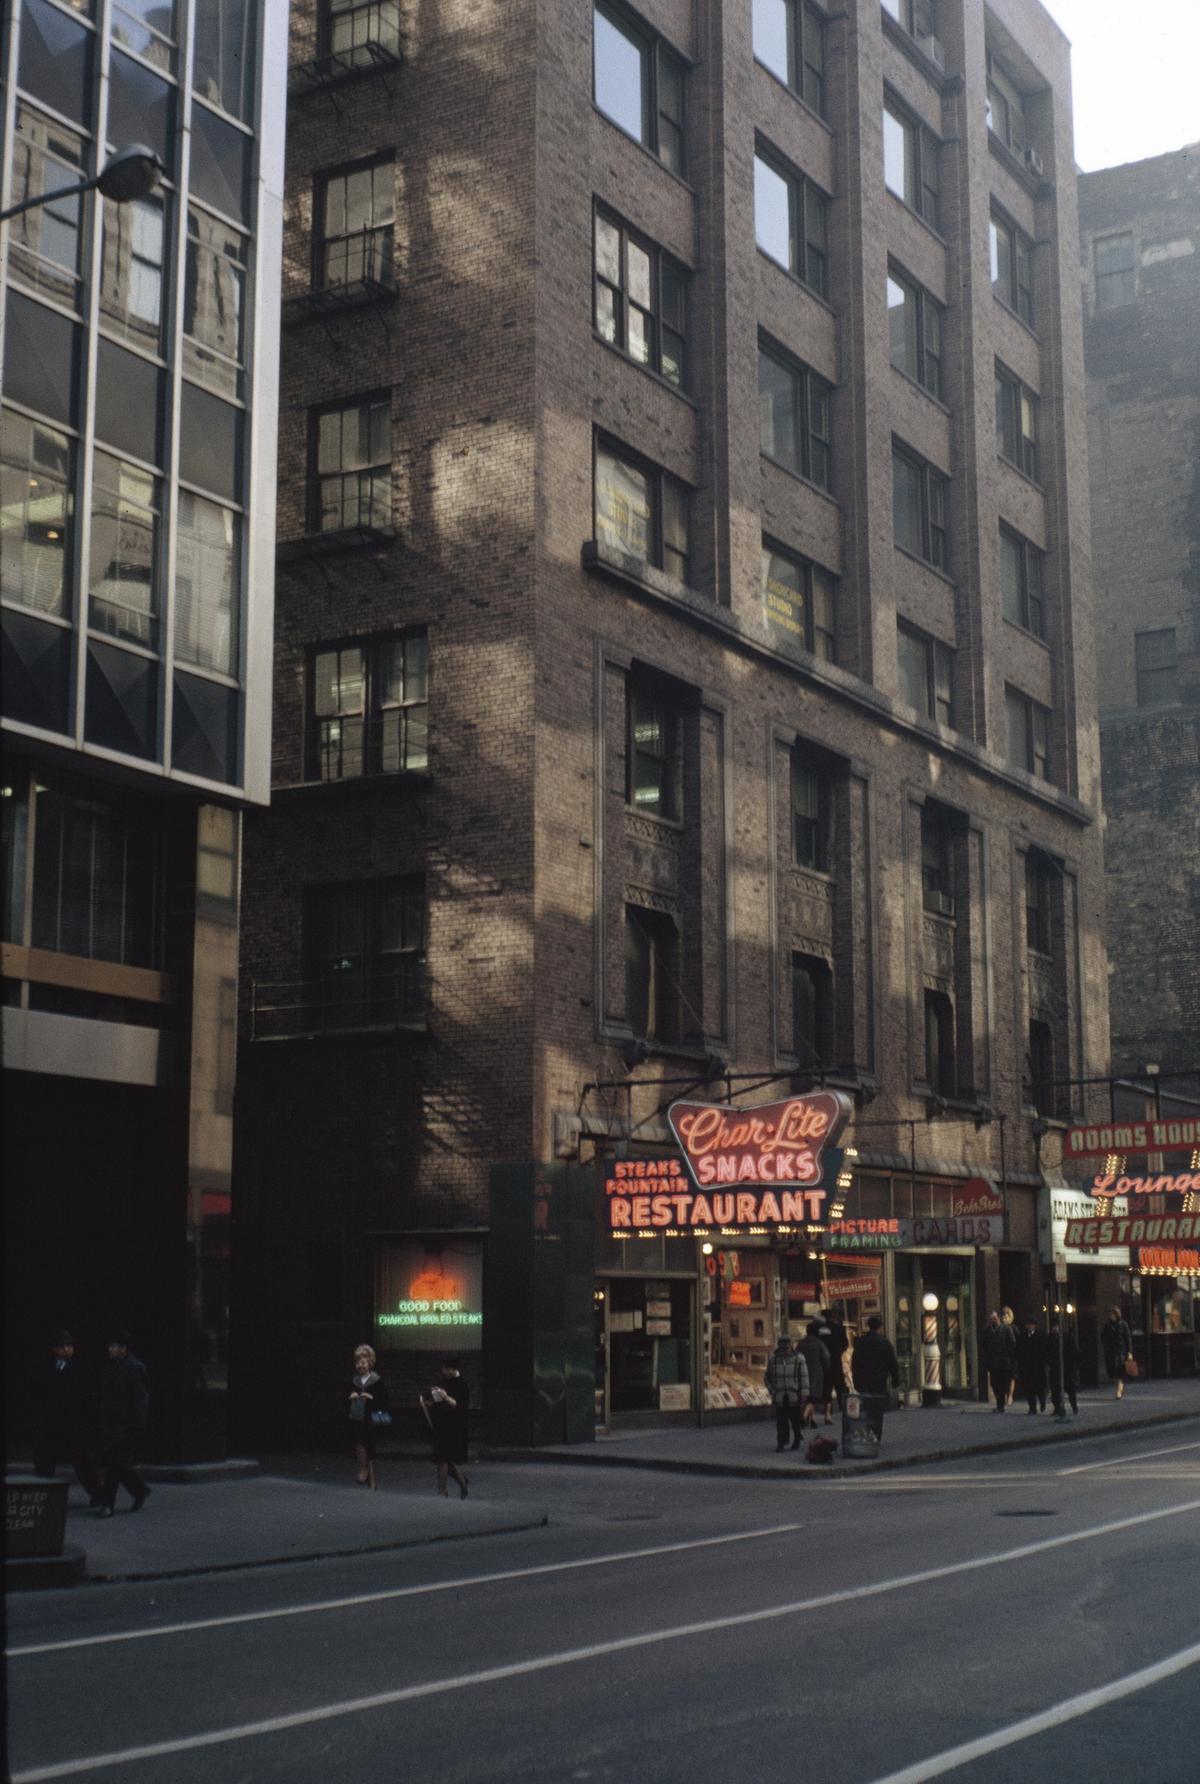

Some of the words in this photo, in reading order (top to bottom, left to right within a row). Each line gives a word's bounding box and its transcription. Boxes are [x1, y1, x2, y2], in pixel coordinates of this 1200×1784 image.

[1071, 1126, 1147, 1151] ADAMS
[614, 1160, 681, 1178] STEAKS
[698, 1152, 816, 1184] SNACKS
[606, 1177, 688, 1195] FOUNTAIN
[610, 1190, 826, 1228] RESTAURANT
[830, 1218, 898, 1233] PICTURE
[913, 1218, 991, 1245] CARDS
[830, 1233, 902, 1248] FRAMING
[399, 1300, 429, 1312] GOOD
[432, 1299, 461, 1311] FOOD
